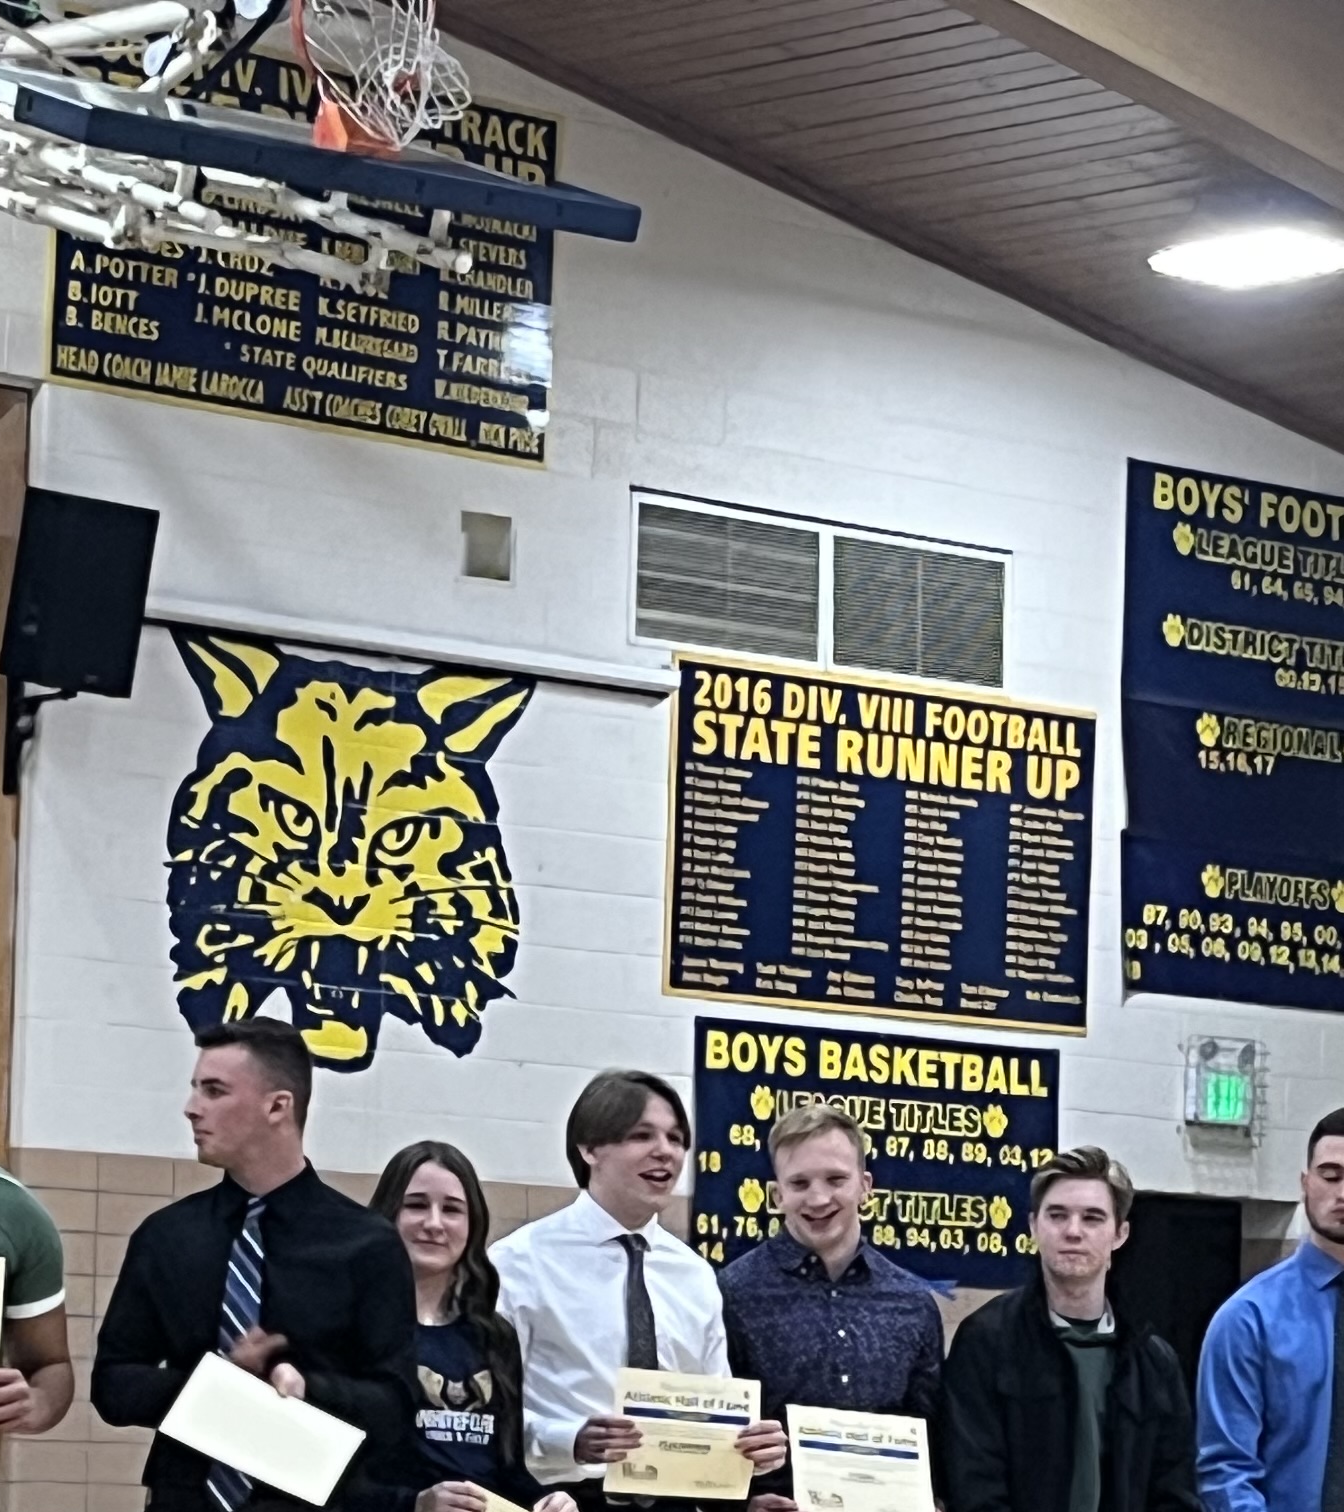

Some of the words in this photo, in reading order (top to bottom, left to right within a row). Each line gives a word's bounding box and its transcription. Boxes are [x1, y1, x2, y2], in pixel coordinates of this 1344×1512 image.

[215, 277, 301, 312] DUPREE
[91, 309, 160, 341] BENCES
[213, 305, 301, 342] MCLONE
[56, 345, 99, 375] HEAD
[103, 352, 152, 384] COACH
[240, 344, 296, 371] STATE
[302, 356, 407, 391] QUALIFIERS
[1195, 527, 1294, 574] LEAGUE
[1185, 618, 1300, 665] DISTRICT
[693, 671, 772, 714] 2016
[783, 682, 846, 726] DIV.
[858, 693, 914, 734] VIII
[925, 701, 1081, 757] FOOTBALL
[693, 710, 821, 769] STATE
[837, 729, 1013, 794] RUNNER
[1026, 755, 1081, 801] UP
[1222, 716, 1343, 763] REGIONAL
[1225, 868, 1331, 911] PLAYOFFS
[705, 1030, 806, 1077] BOYS
[819, 1039, 1048, 1097] BASKETBALL
[889, 1099, 982, 1138] TITLES
[894, 1190, 987, 1228] TITLES
